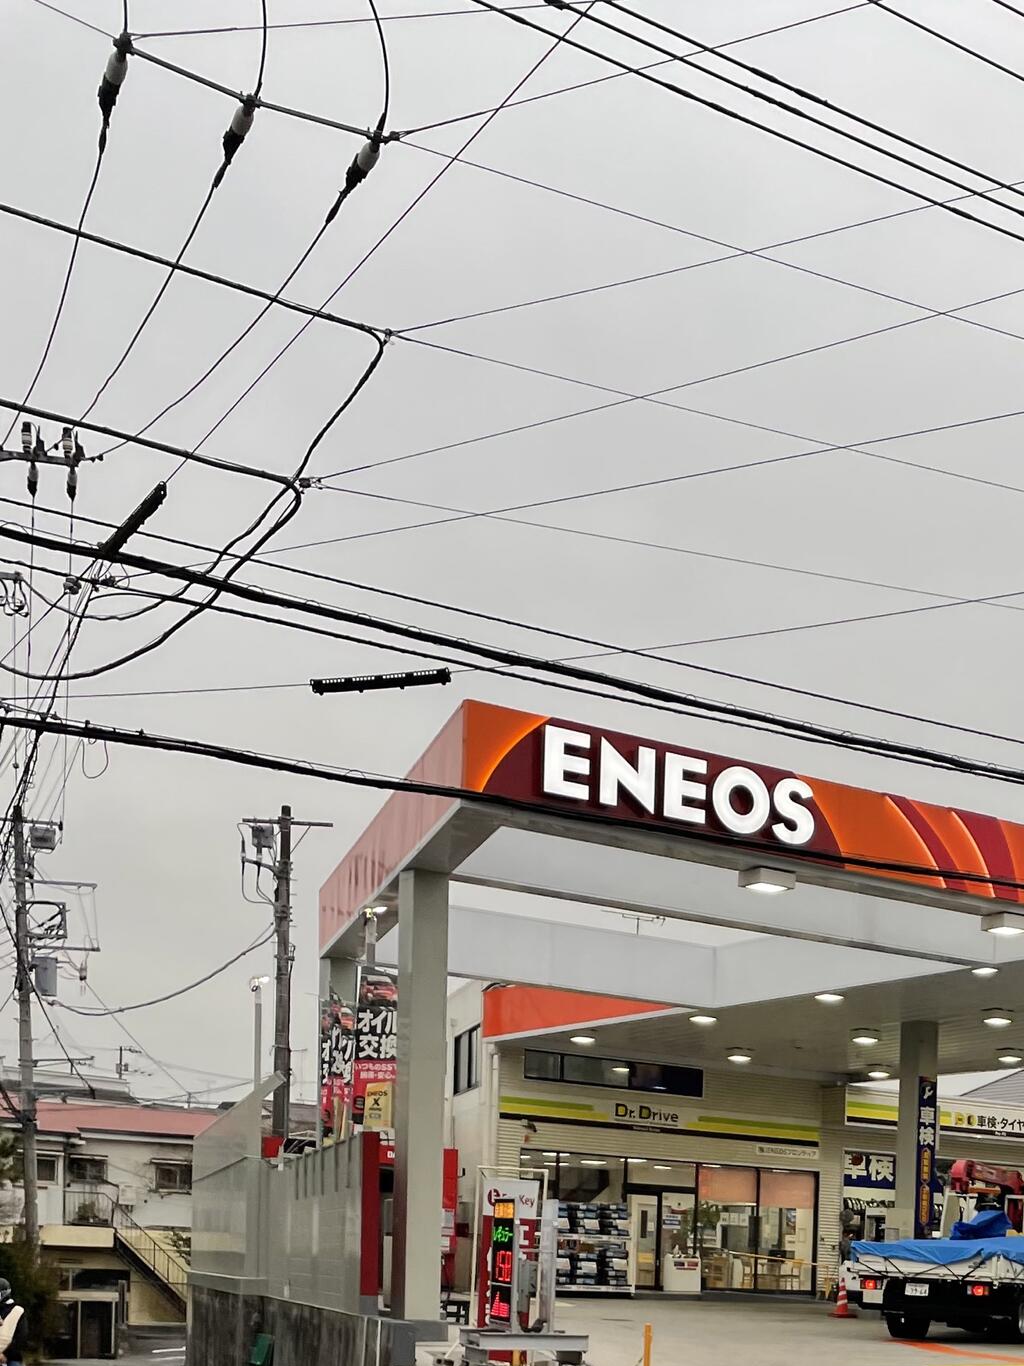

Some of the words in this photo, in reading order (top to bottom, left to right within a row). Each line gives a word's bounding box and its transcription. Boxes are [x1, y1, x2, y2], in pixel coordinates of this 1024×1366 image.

[543, 724, 815, 845] ENEOS
[358, 1009, 397, 1034] オイル
[359, 1034, 397, 1059] 交換
[615, 1103, 636, 1118] Dr.
[639, 1105, 679, 1122] Drive
[919, 1106, 935, 1146] 車検
